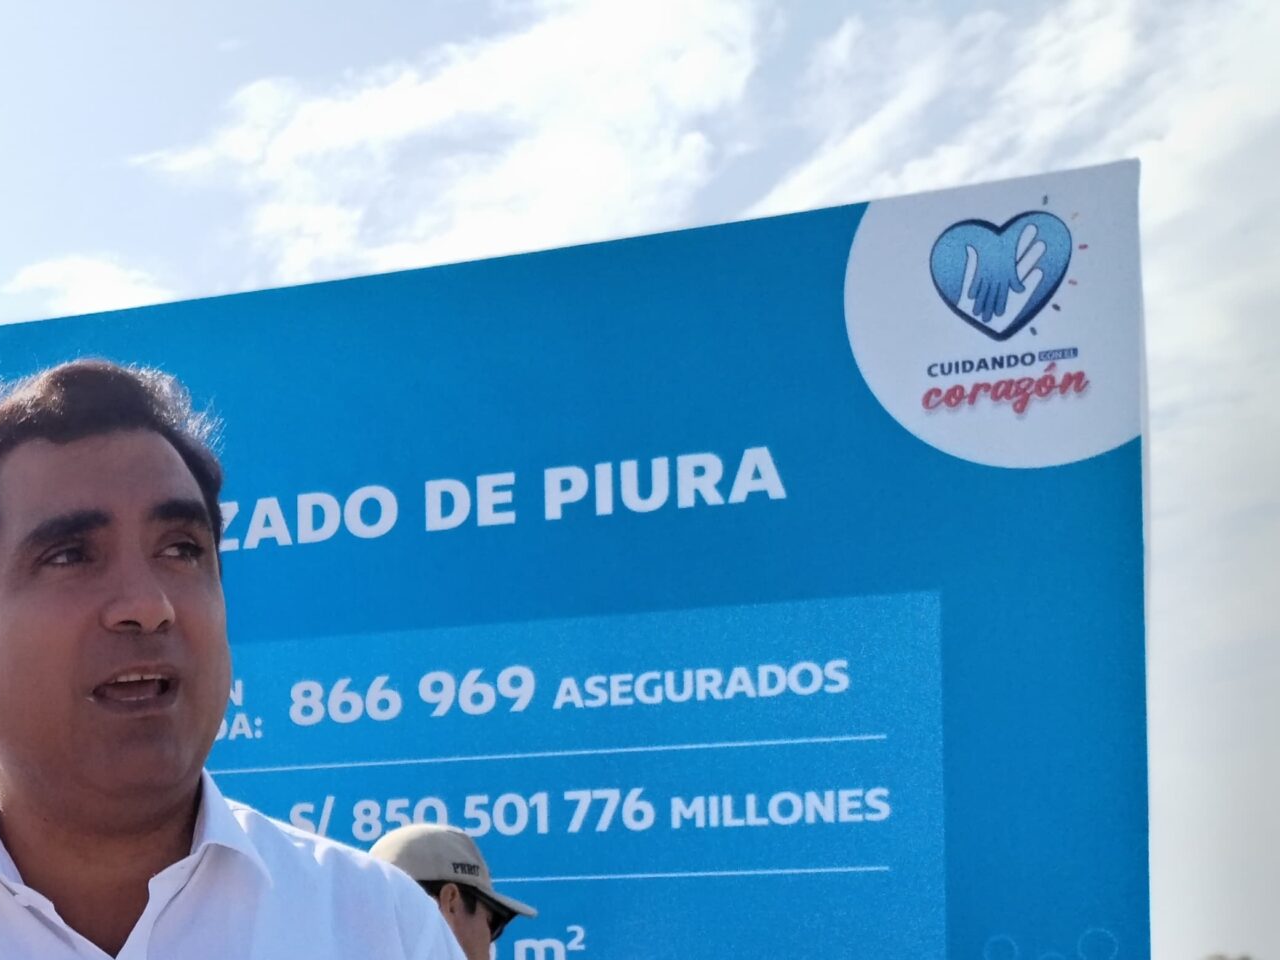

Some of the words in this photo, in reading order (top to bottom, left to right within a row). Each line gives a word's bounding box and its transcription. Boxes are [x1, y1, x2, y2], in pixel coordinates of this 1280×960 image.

[921, 361, 1091, 415] corazón
[926, 351, 1037, 378] CUIDANDO
[424, 471, 517, 532] DE
[543, 446, 787, 521] PIURA
[288, 673, 403, 727] 866
[417, 664, 536, 718] 969
[551, 659, 851, 710] ASEGURADOS
[463, 791, 550, 838] 501
[563, 787, 657, 833] 776
[670, 787, 892, 830] MILLONES
